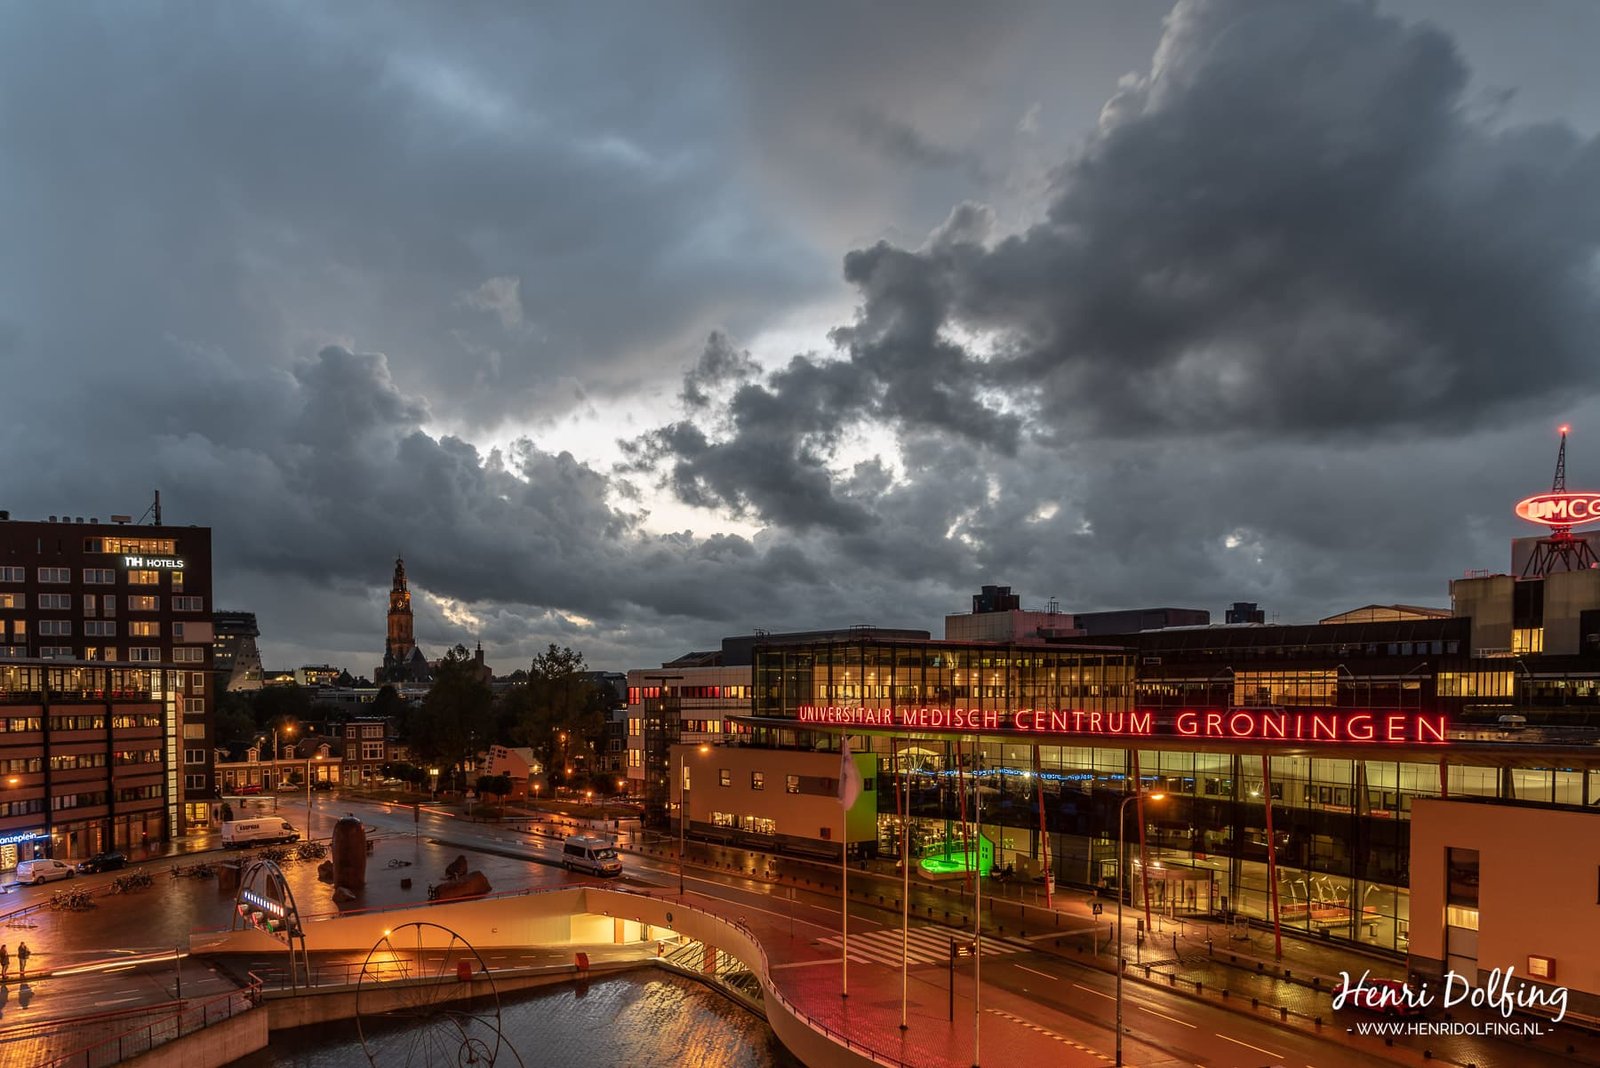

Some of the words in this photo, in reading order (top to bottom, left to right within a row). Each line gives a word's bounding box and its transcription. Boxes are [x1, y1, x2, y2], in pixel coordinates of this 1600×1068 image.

[1528, 499, 1600, 518] UMCG
[146, 559, 184, 568] HOTELS
[799, 706, 892, 725] UNIVERSITAIR
[903, 708, 998, 728] MEDISCH
[1015, 709, 1151, 733] CENTRUM
[1177, 713, 1445, 741] GRONINGEN
